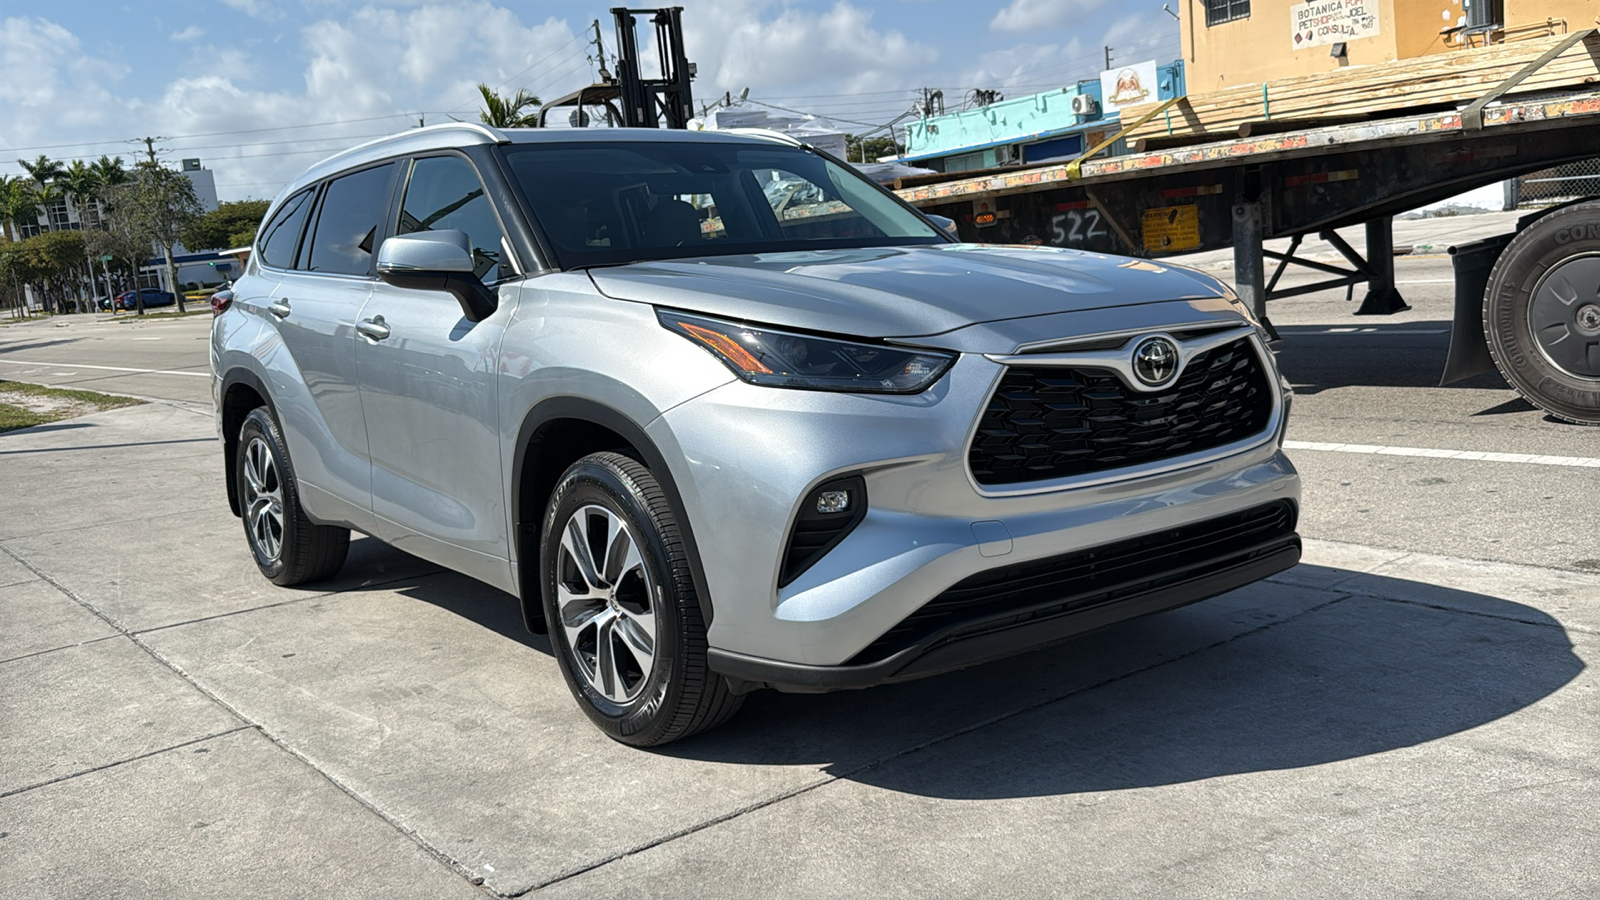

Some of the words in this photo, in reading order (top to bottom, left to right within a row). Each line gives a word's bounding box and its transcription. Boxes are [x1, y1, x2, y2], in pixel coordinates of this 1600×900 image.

[1297, 0, 1343, 20] BOTANICA
[1346, 6, 1368, 19] JOEL
[1144, 211, 1170, 220] WARNIN
[1051, 210, 1107, 244] 522
